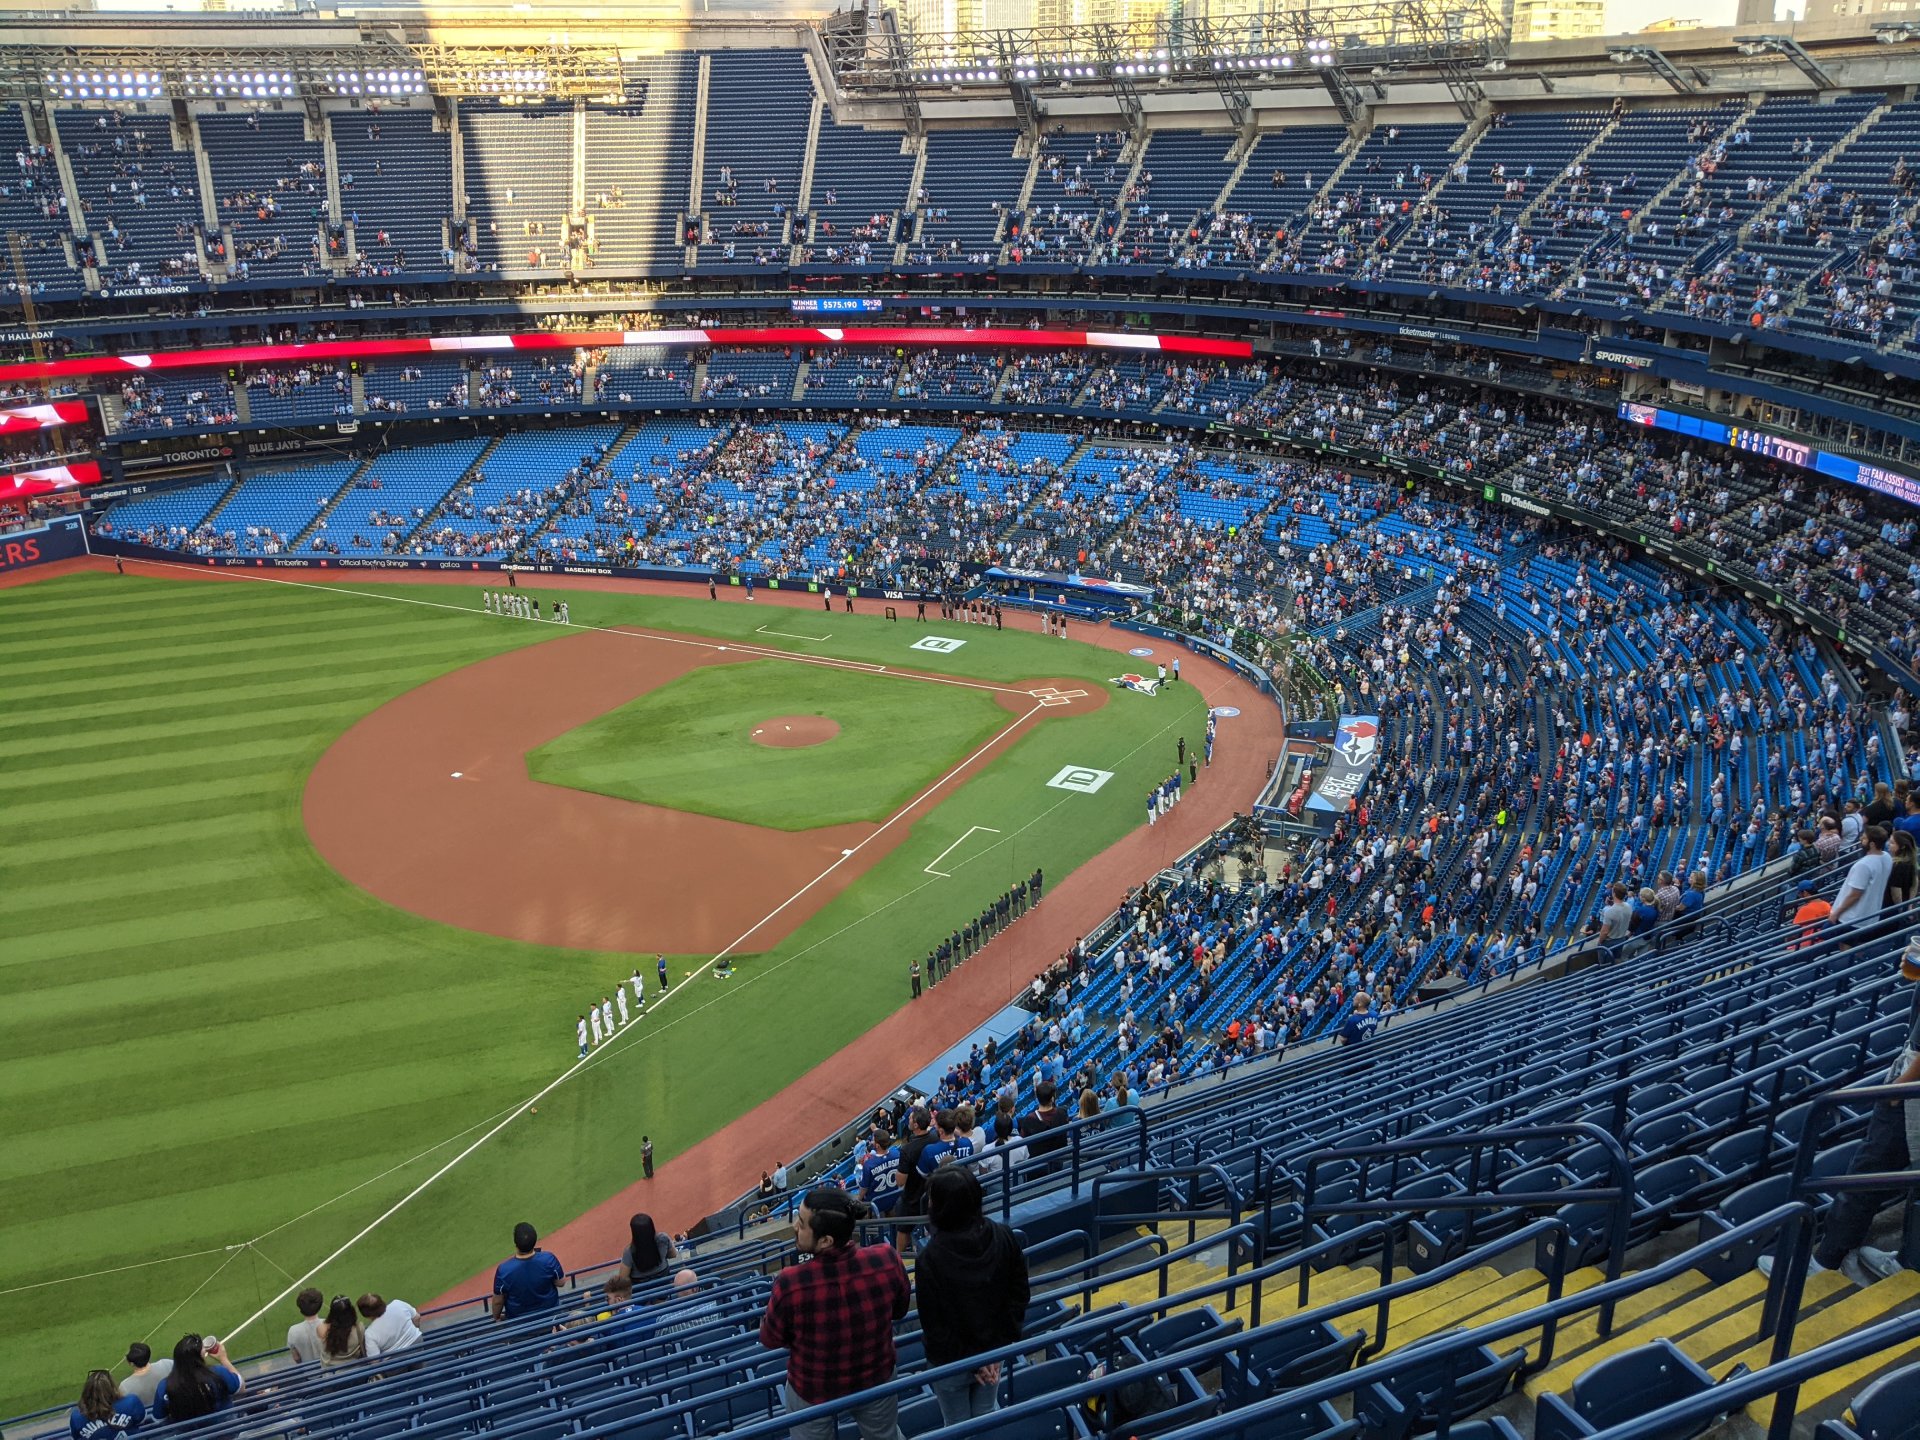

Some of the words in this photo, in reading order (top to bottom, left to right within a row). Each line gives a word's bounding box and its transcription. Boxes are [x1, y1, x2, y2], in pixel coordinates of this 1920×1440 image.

[114, 288, 143, 297] JACKIE
[145, 286, 189, 295] ROBINSON
[8, 330, 54, 341] HALLADAY
[1399, 326, 1437, 338] ticketmaster
[1595, 351, 1654, 368] SPORTSNET
[248, 442, 274, 453] BLUE
[275, 440, 301, 451] JAYS
[165, 448, 219, 463] TORONTO
[1856, 475, 1870, 484] SEAT
[1858, 466, 1871, 477] TEXT
[1871, 469, 1885, 481] FAN
[1884, 472, 1905, 487] ASSIST
[91, 489, 127, 500] theScore
[132, 486, 147, 494] BET
[1501, 492, 1512, 503] TD
[1511, 497, 1550, 516] Clubhouse
[65, 521, 79, 530] 328
[274, 558, 308, 567] Timberline
[386, 560, 409, 568] Shingle
[500, 563, 535, 571] theScore
[564, 566, 597, 574] BASELINE
[884, 590, 904, 599] VISA
[1321, 776, 1341, 797] NEXT
[1342, 772, 1364, 795] LEVEL
[874, 1169, 899, 1192] 20
